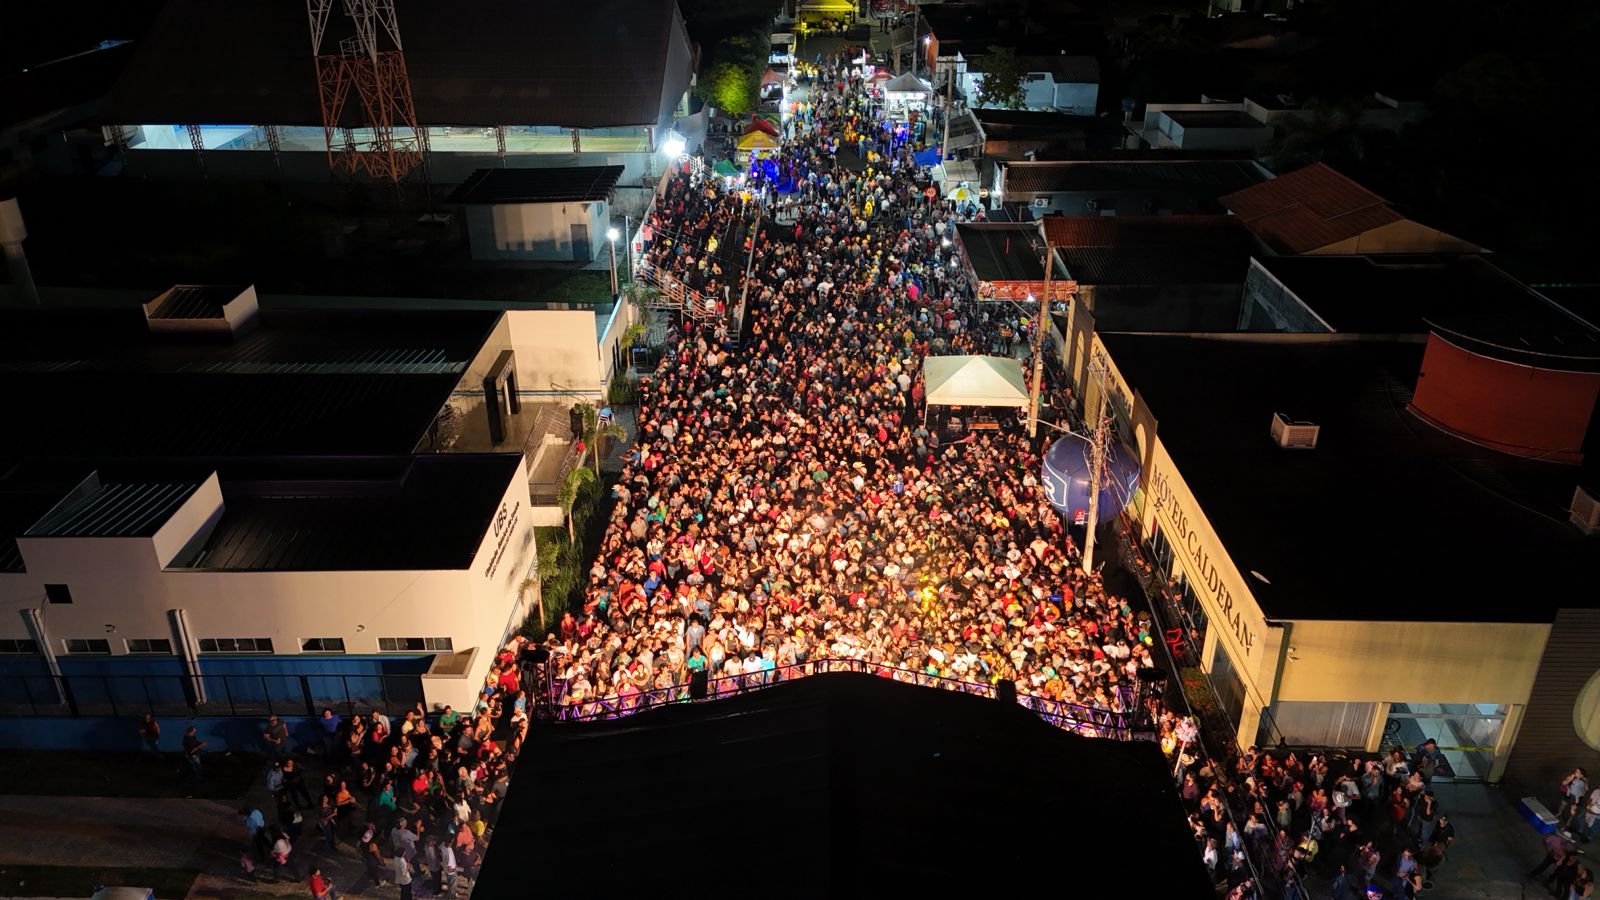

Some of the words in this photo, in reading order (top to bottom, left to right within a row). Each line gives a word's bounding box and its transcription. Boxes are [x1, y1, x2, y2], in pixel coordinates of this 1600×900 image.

[493, 502, 508, 538] UBS
[1152, 464, 1189, 539] MÓVEIS
[1187, 531, 1255, 656] CALDERAN
